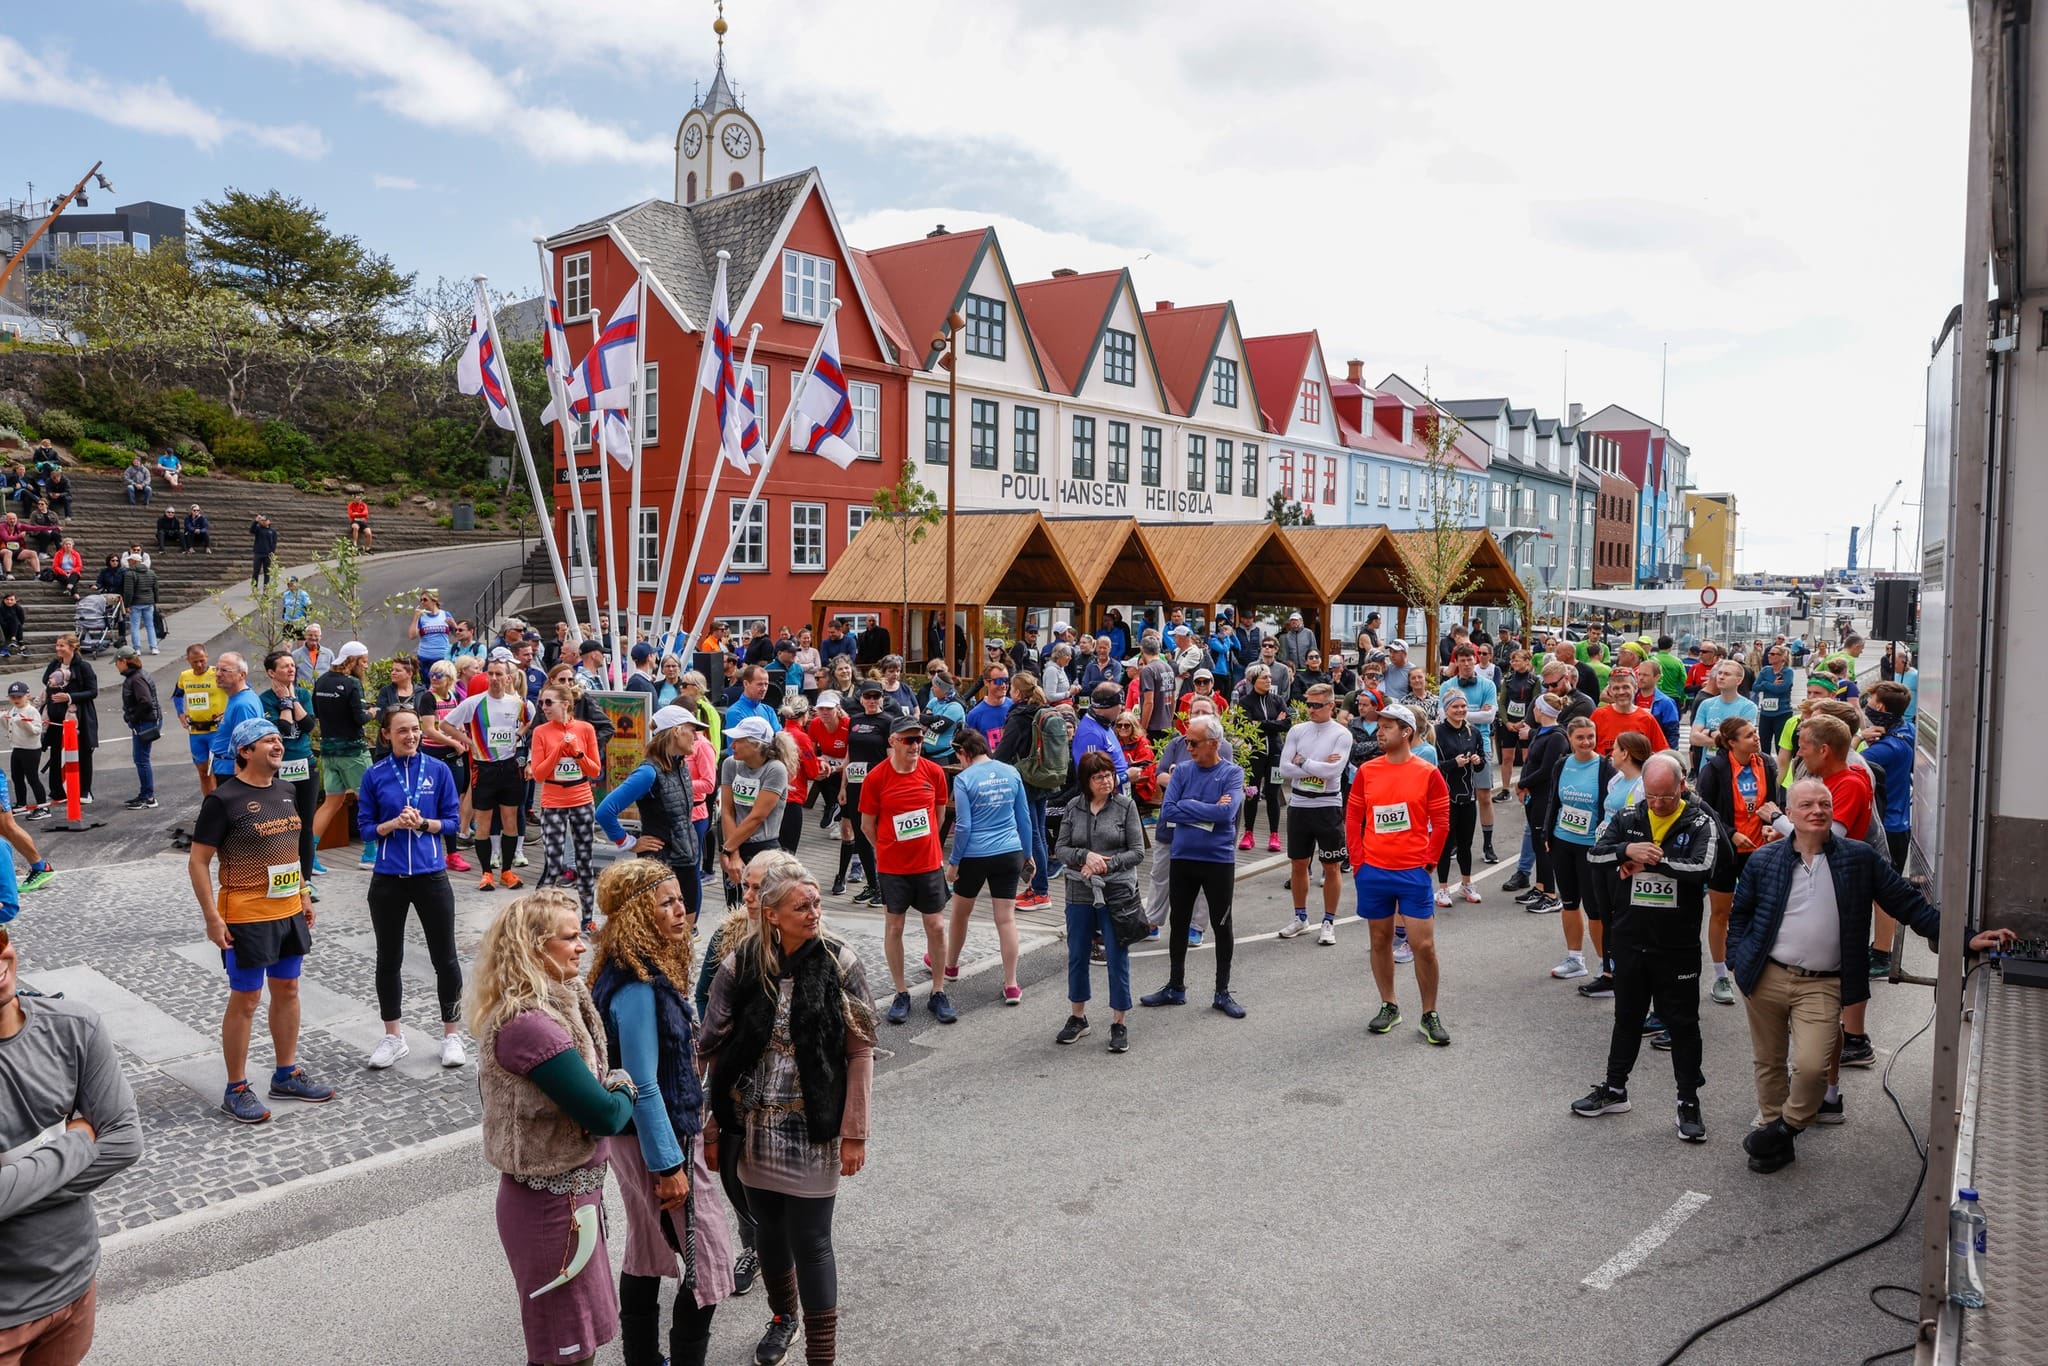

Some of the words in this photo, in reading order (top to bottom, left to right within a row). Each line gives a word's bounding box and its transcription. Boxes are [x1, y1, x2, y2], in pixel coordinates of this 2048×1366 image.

[1002, 474, 1049, 501] POUL
[1056, 479, 1126, 507] HANSEN
[491, 732, 511, 740] 7001
[282, 765, 306, 774] 7166
[897, 816, 927, 831] 7058
[1376, 811, 1405, 823] 7087
[1562, 811, 1587, 826] 2033
[1635, 881, 1673, 895] 5036
